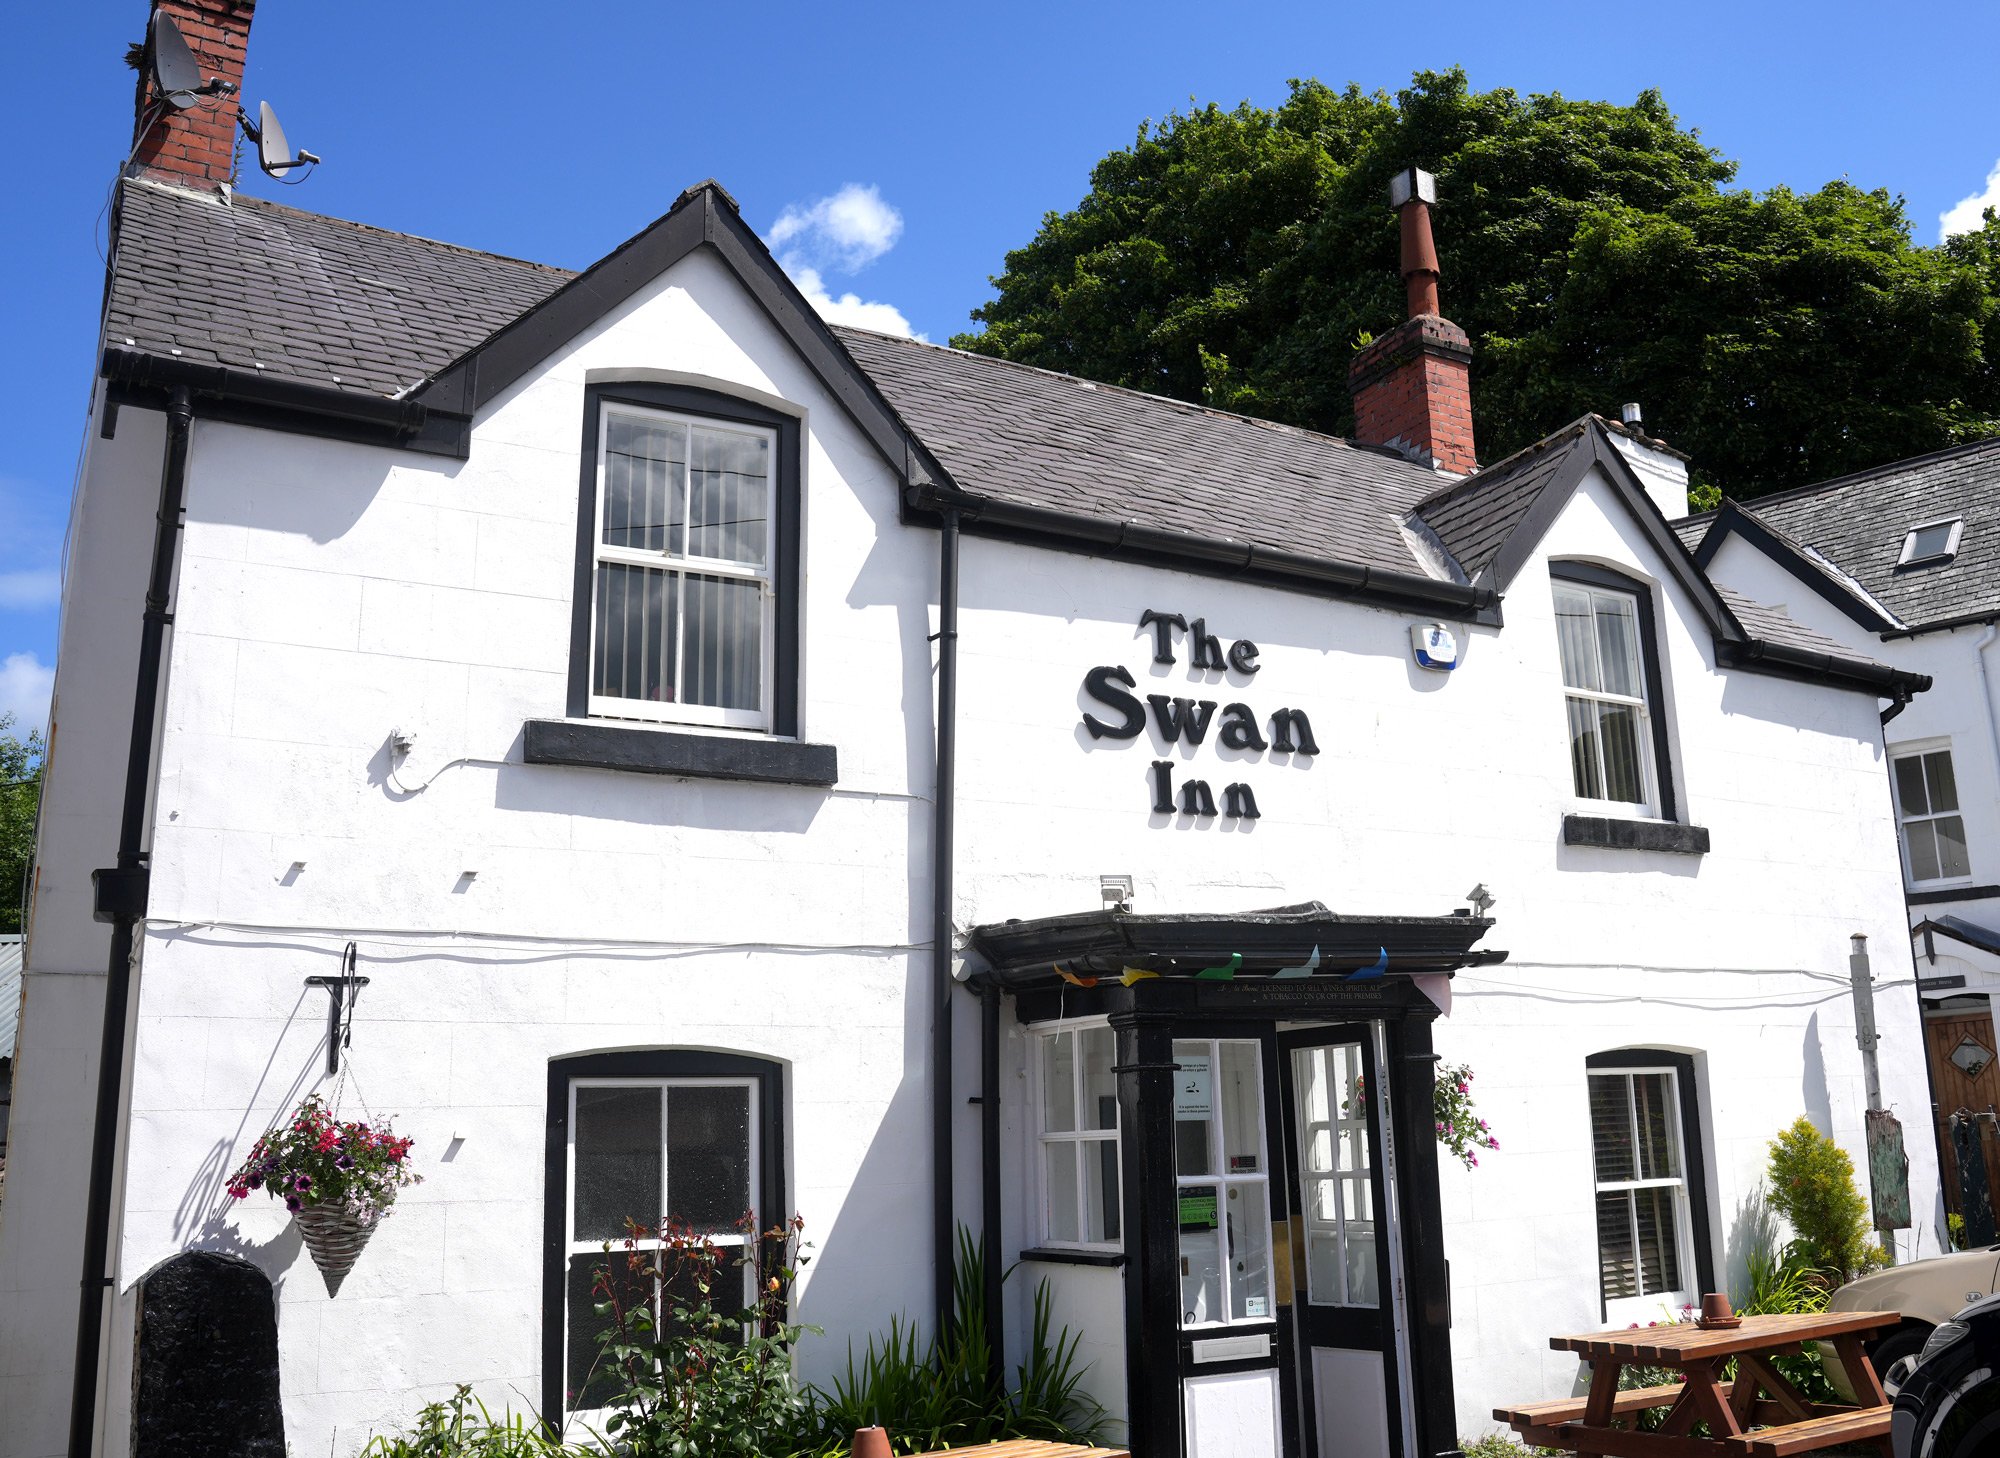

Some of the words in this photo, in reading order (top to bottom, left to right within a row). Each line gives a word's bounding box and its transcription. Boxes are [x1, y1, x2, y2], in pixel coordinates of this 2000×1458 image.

[1140, 609, 1261, 675] The
[1083, 665, 1321, 756] Swan
[1151, 760, 1261, 819] Inn
[1262, 984, 1294, 992] LICENSED
[1296, 984, 1306, 992] TO
[1307, 984, 1320, 992] SELL
